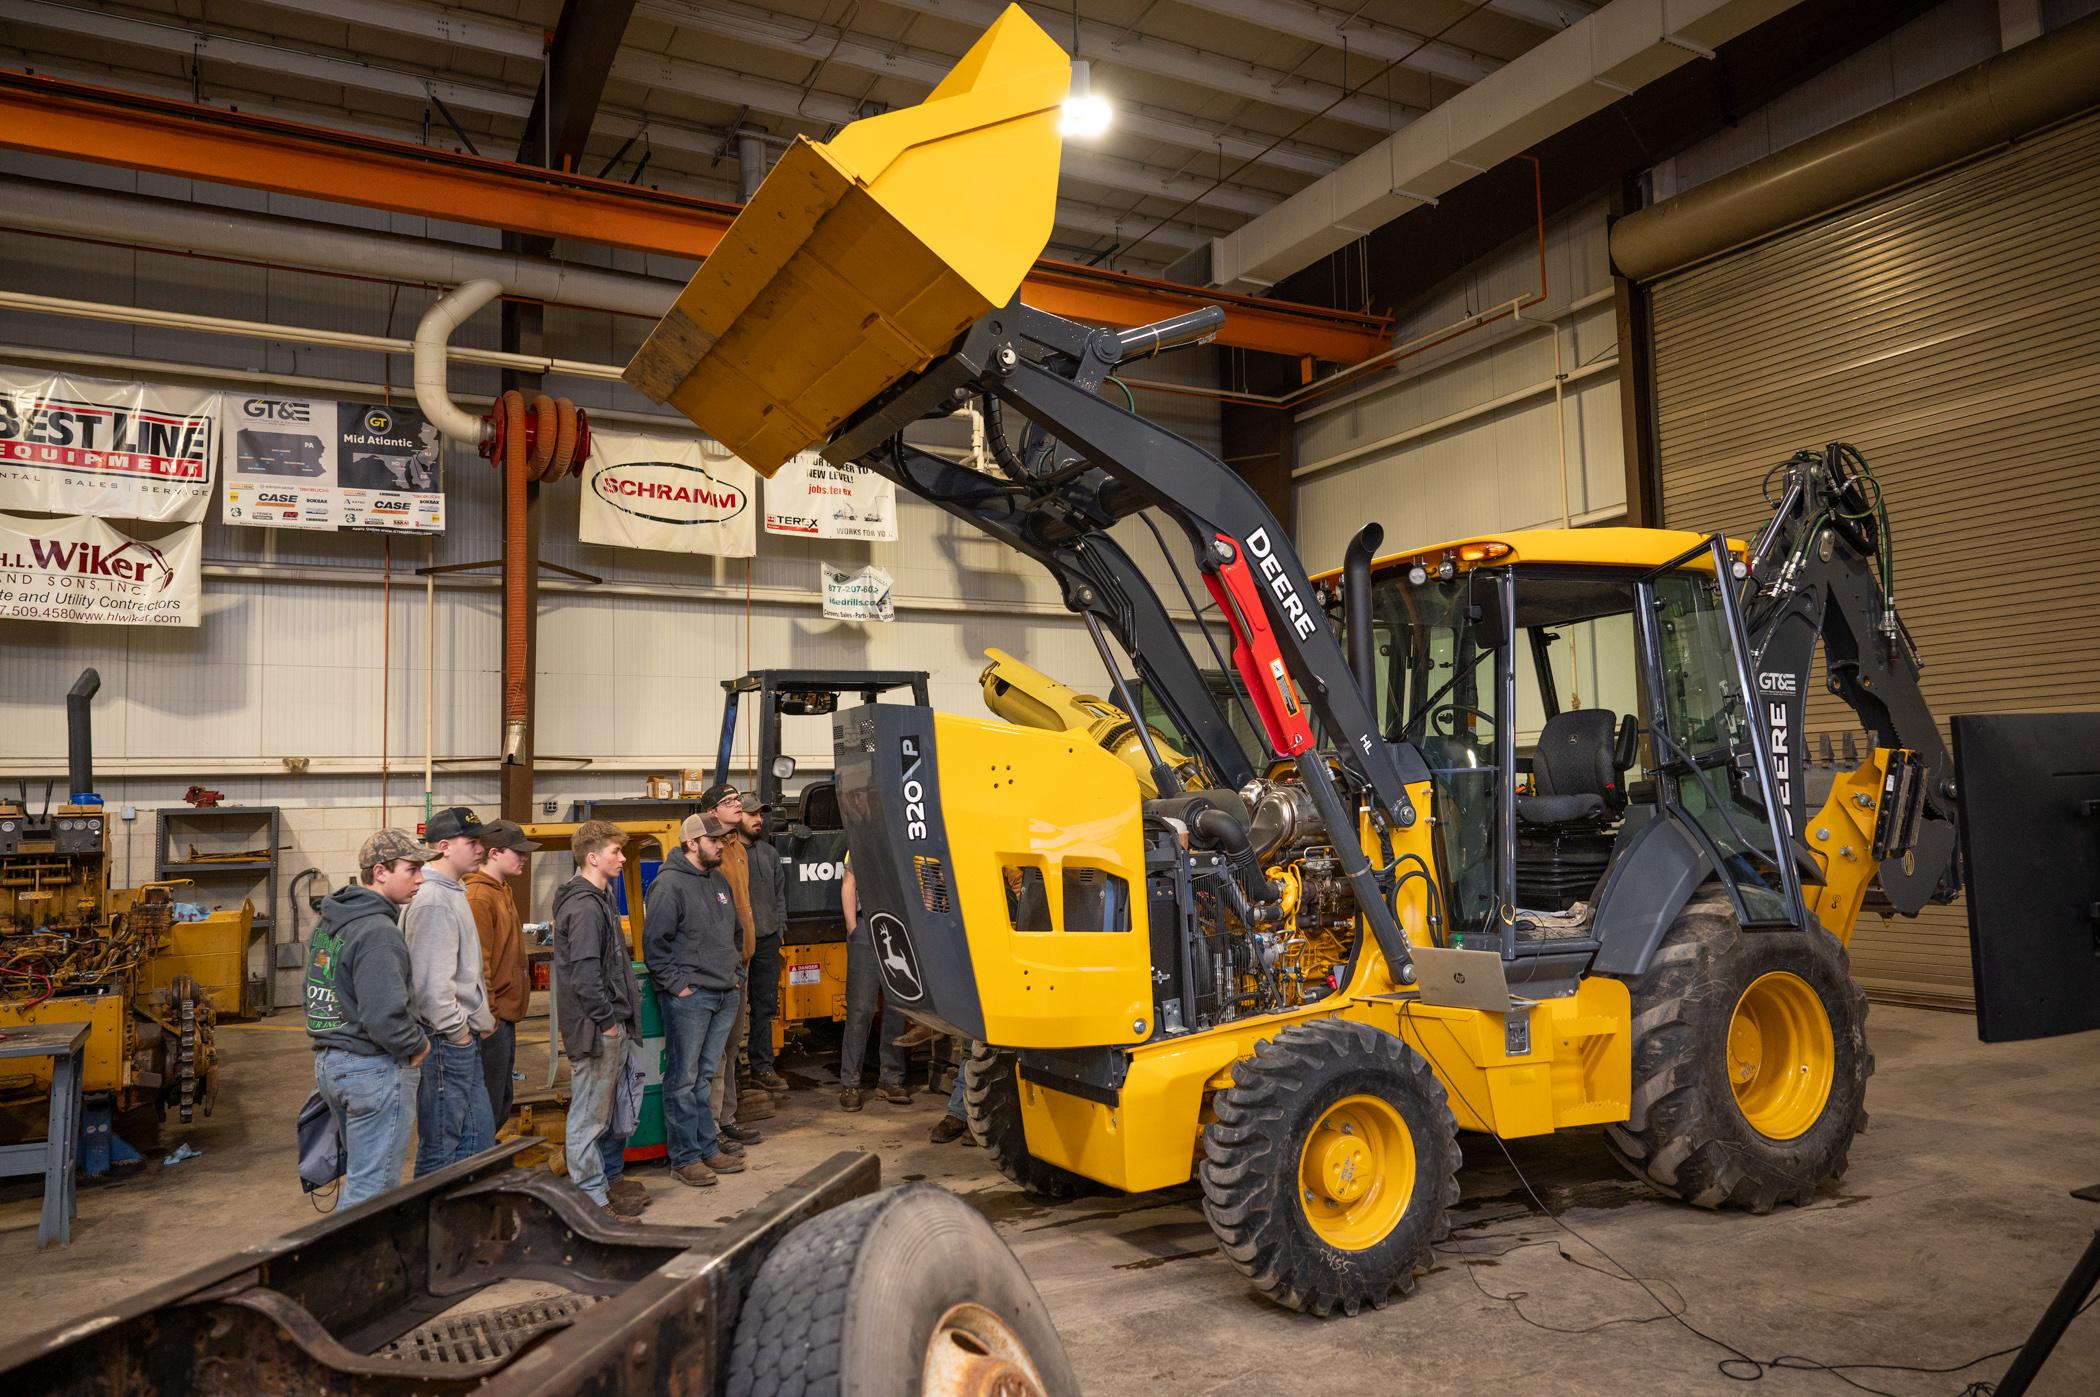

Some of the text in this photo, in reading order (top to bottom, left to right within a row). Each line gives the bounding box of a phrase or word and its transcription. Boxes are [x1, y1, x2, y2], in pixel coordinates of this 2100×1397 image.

[370, 417, 387, 427] GT
[344, 434, 413, 448] Mid Atlantic
[64, 478, 118, 489] SALES
[258, 493, 298, 503] CASE
[603, 478, 736, 509] SCHRAMM
[374, 501, 411, 511] CASE
[29, 539, 152, 582] Wiker
[0, 573, 32, 585] ND
[1246, 526, 1316, 641] DEERE
[18, 591, 50, 604] and
[55, 592, 95, 609] Utility
[100, 596, 181, 612] Contractors
[1759, 672, 1796, 691] GT&E
[1360, 734, 1372, 756] HL
[903, 780, 927, 840] 320
